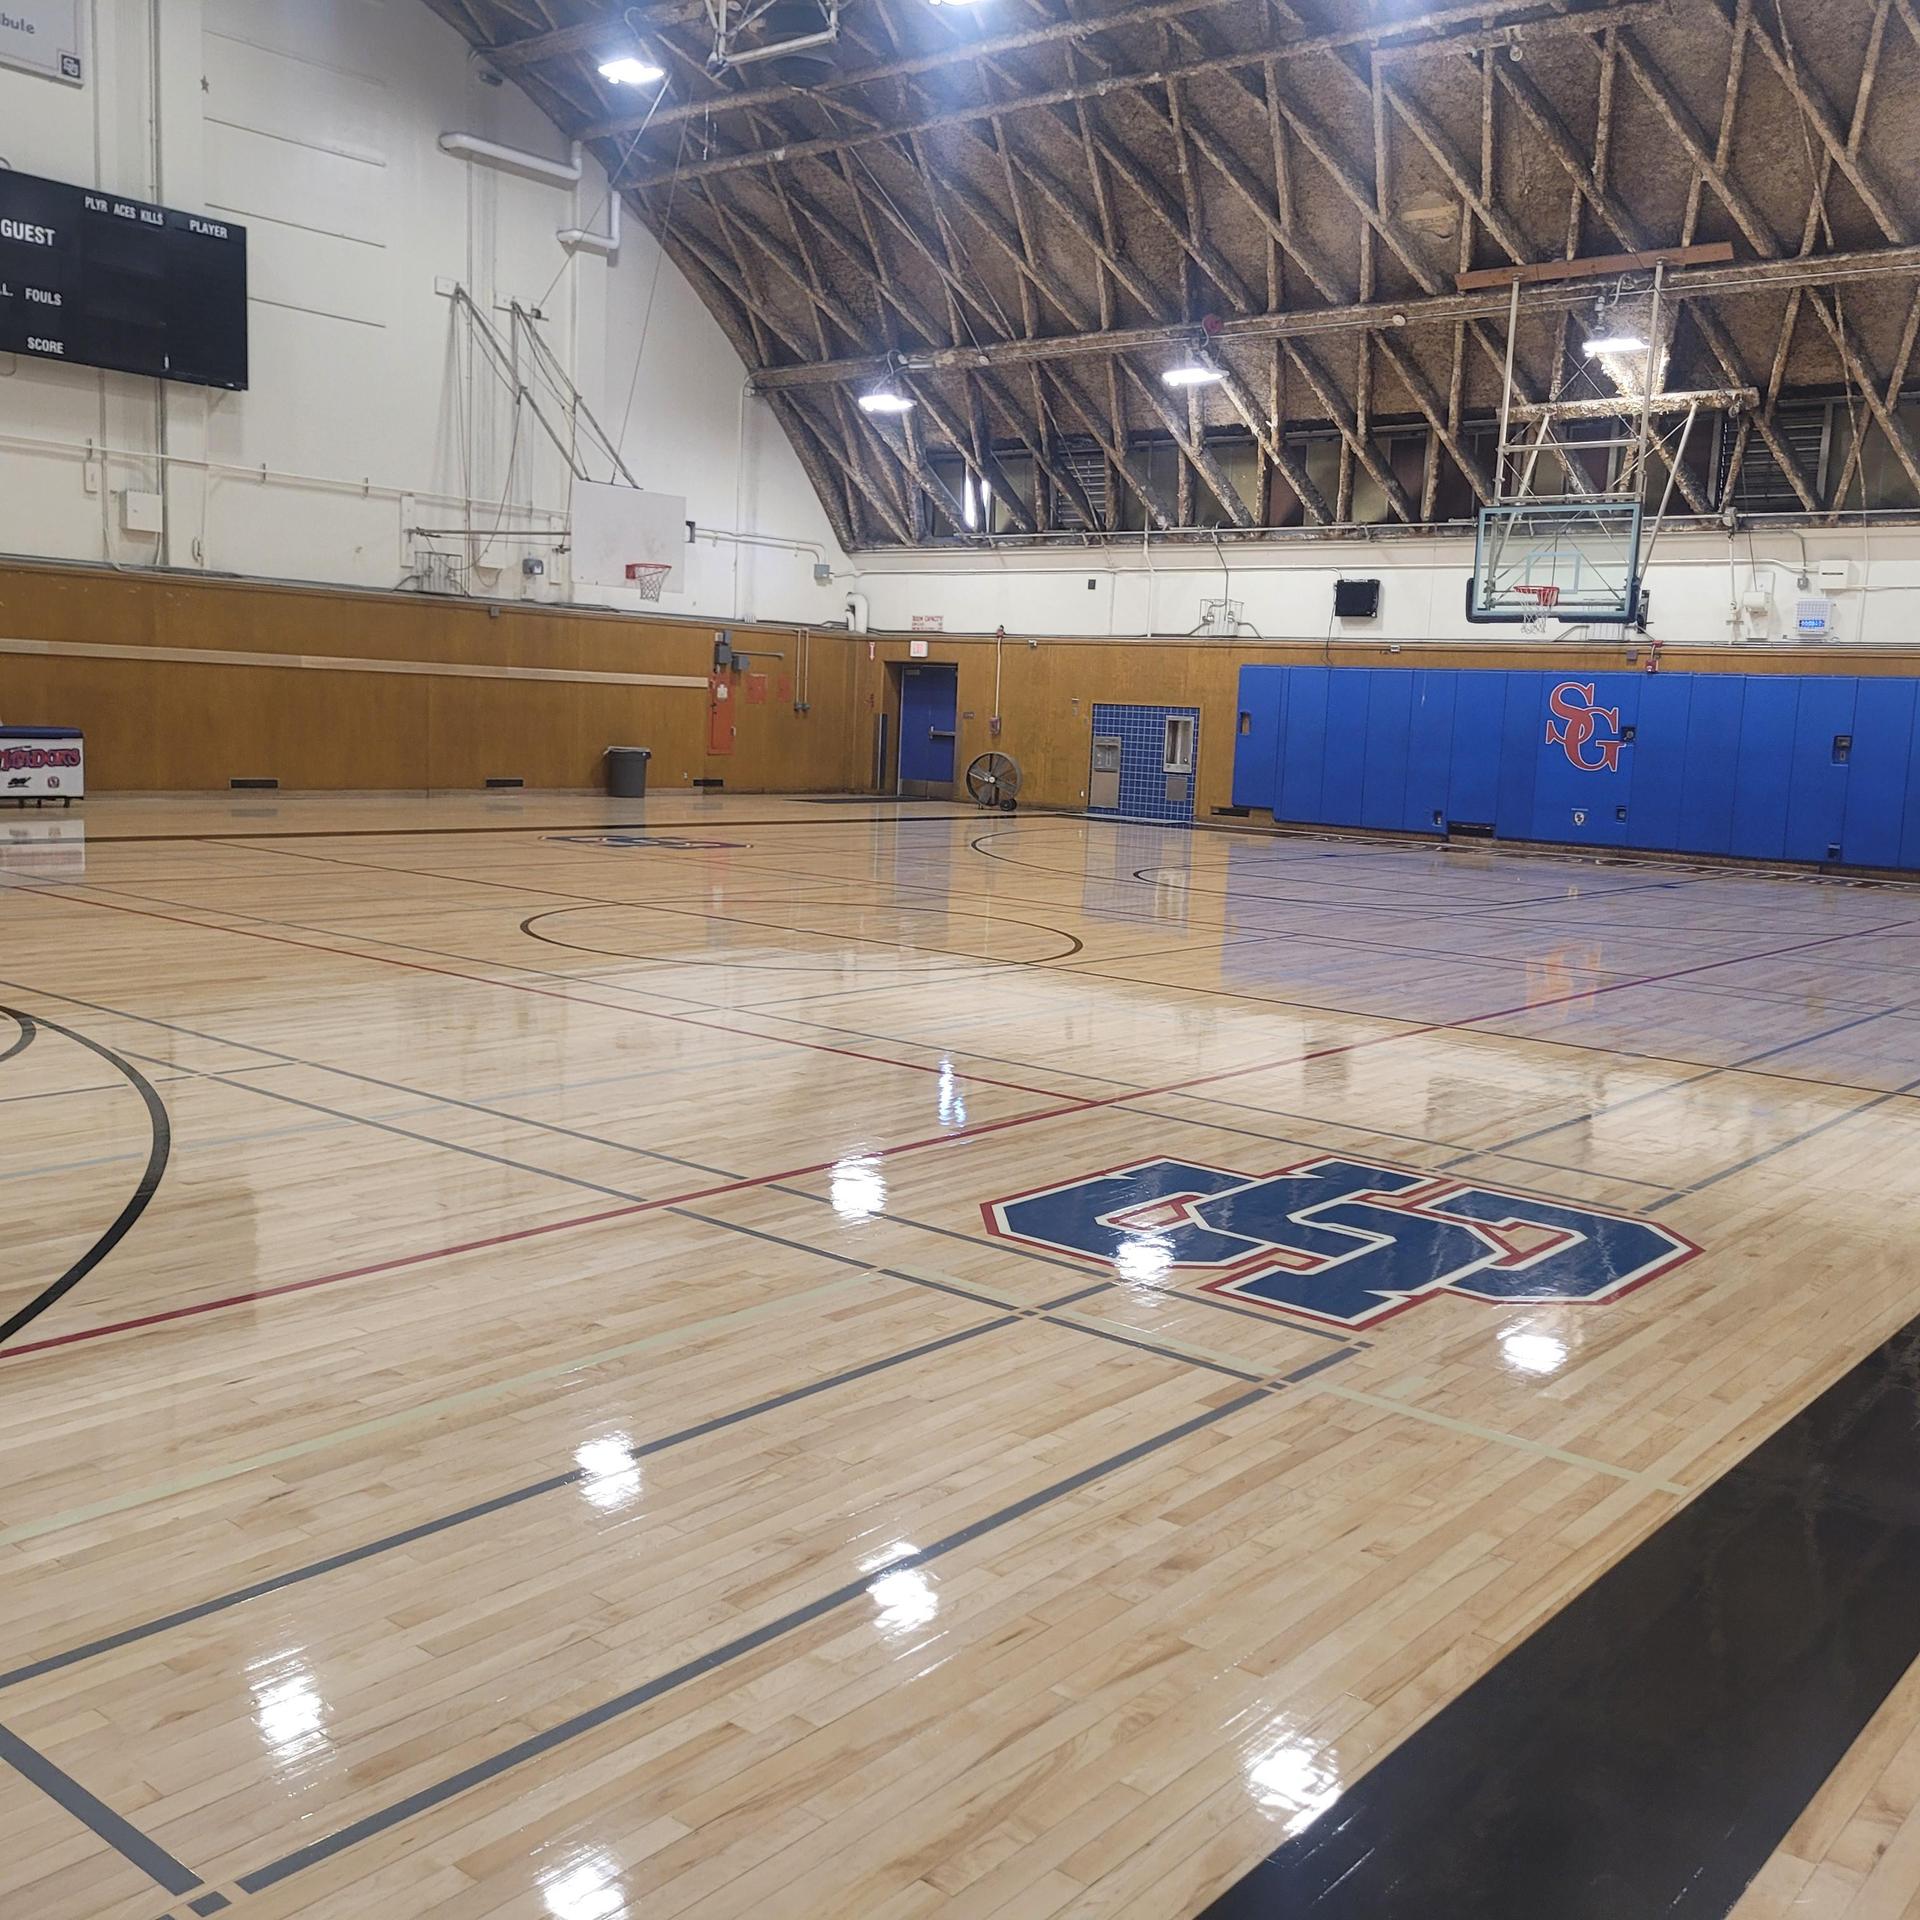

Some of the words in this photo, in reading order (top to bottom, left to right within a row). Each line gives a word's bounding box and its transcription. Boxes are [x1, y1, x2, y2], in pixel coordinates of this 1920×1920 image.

[0, 12, 35, 35] bule
[84, 195, 108, 213] PLYR
[113, 202, 137, 220] ACES
[140, 209, 164, 226] KILLS
[189, 219, 228, 239] PLAYER
[0, 218, 56, 247] GUEST
[25, 287, 63, 306] FOULS
[27, 336, 65, 354] SCORE
[1545, 681, 1627, 772] SG
